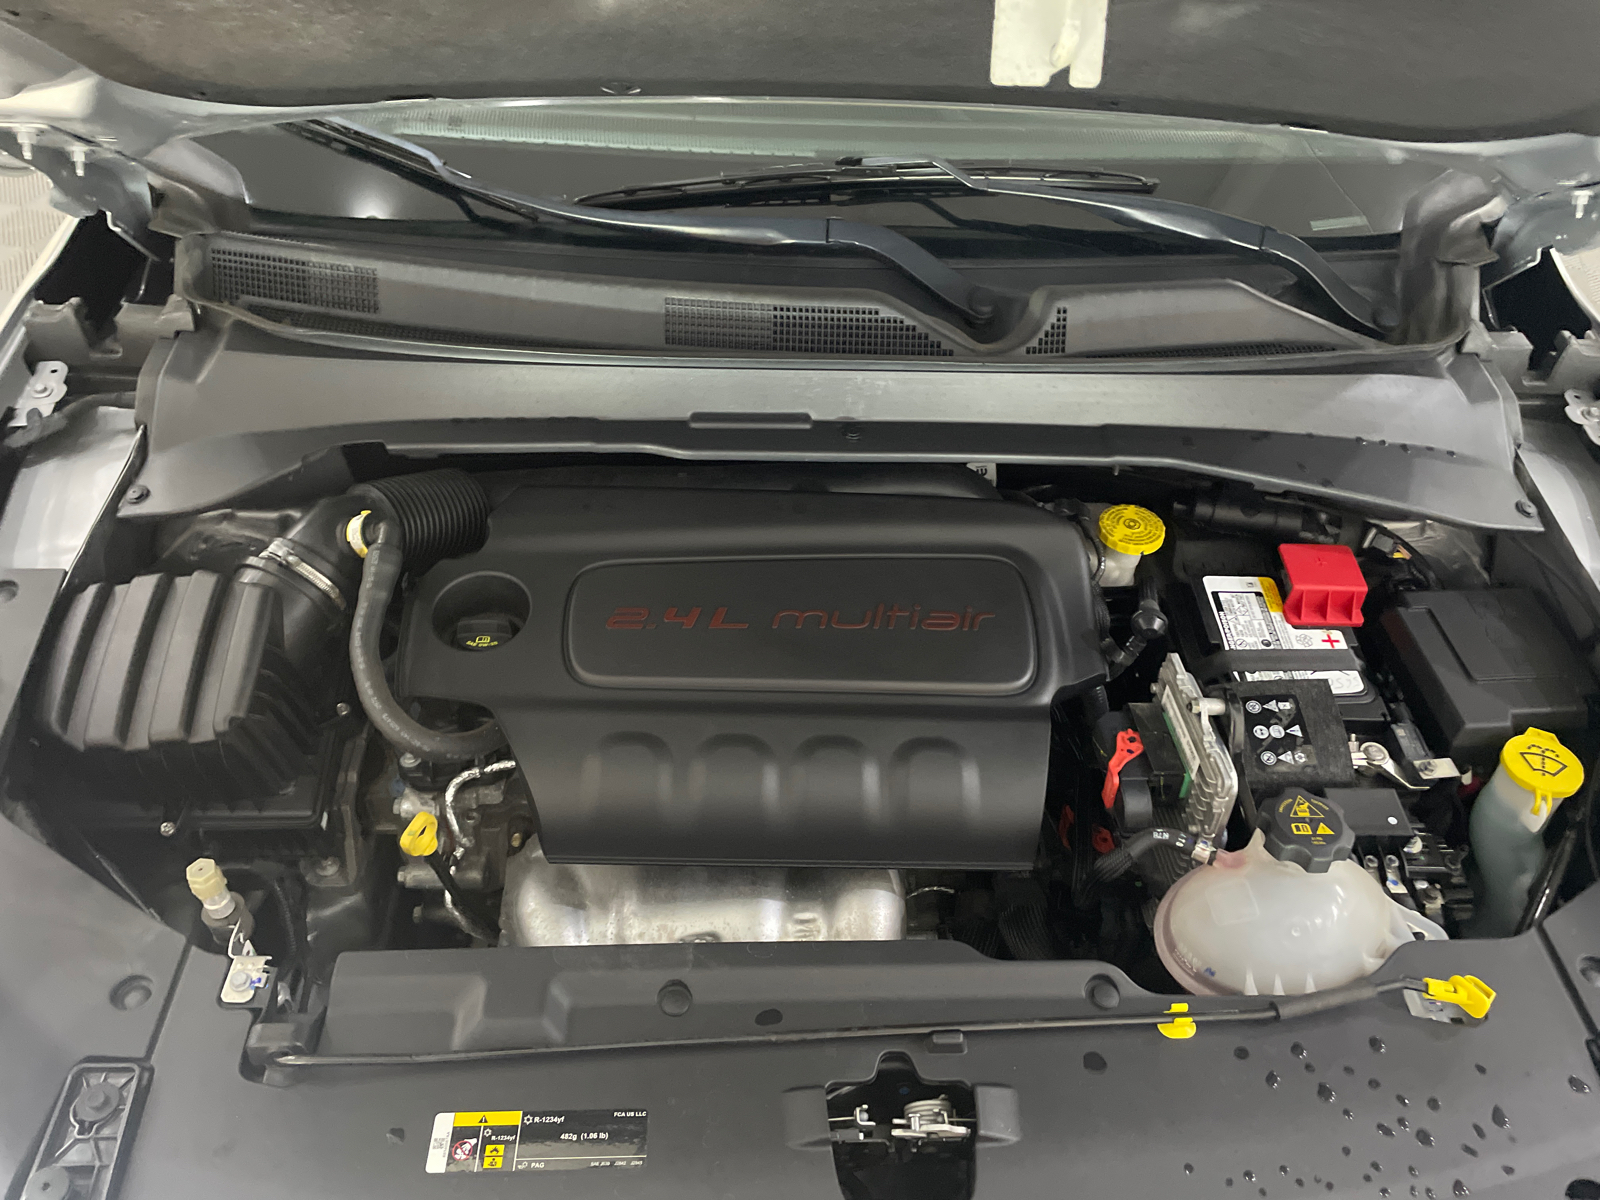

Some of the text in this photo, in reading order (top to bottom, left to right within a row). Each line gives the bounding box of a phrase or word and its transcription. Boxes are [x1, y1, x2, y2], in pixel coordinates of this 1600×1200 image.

[771, 602, 996, 632] multiair
[533, 1115, 565, 1124] R-1234yf
[490, 1134, 516, 1142] R-1234yf
